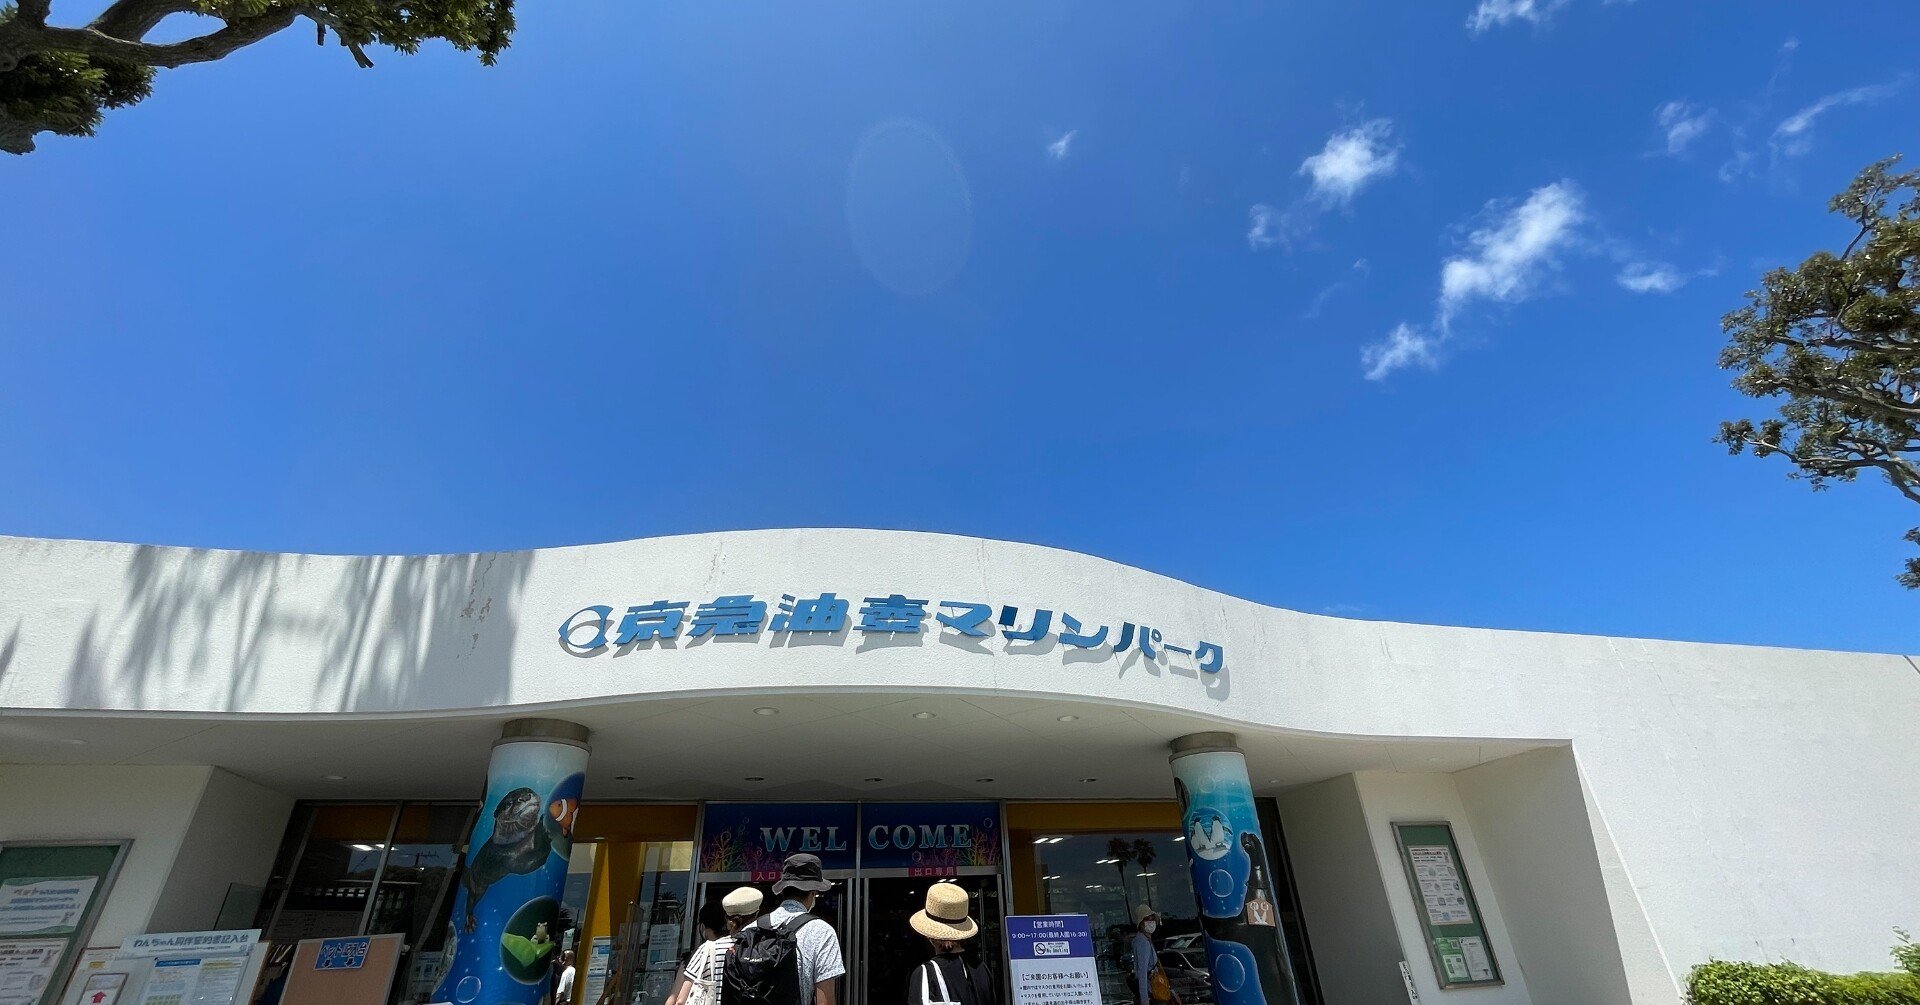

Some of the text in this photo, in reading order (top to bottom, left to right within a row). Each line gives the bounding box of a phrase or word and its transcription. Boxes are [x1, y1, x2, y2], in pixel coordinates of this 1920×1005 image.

[613, 592, 1224, 674] 京急油壺マリンパーク
[760, 824, 972, 852] WEL COME
[756, 871, 776, 881] 入口
[914, 866, 954, 877] 出口専用
